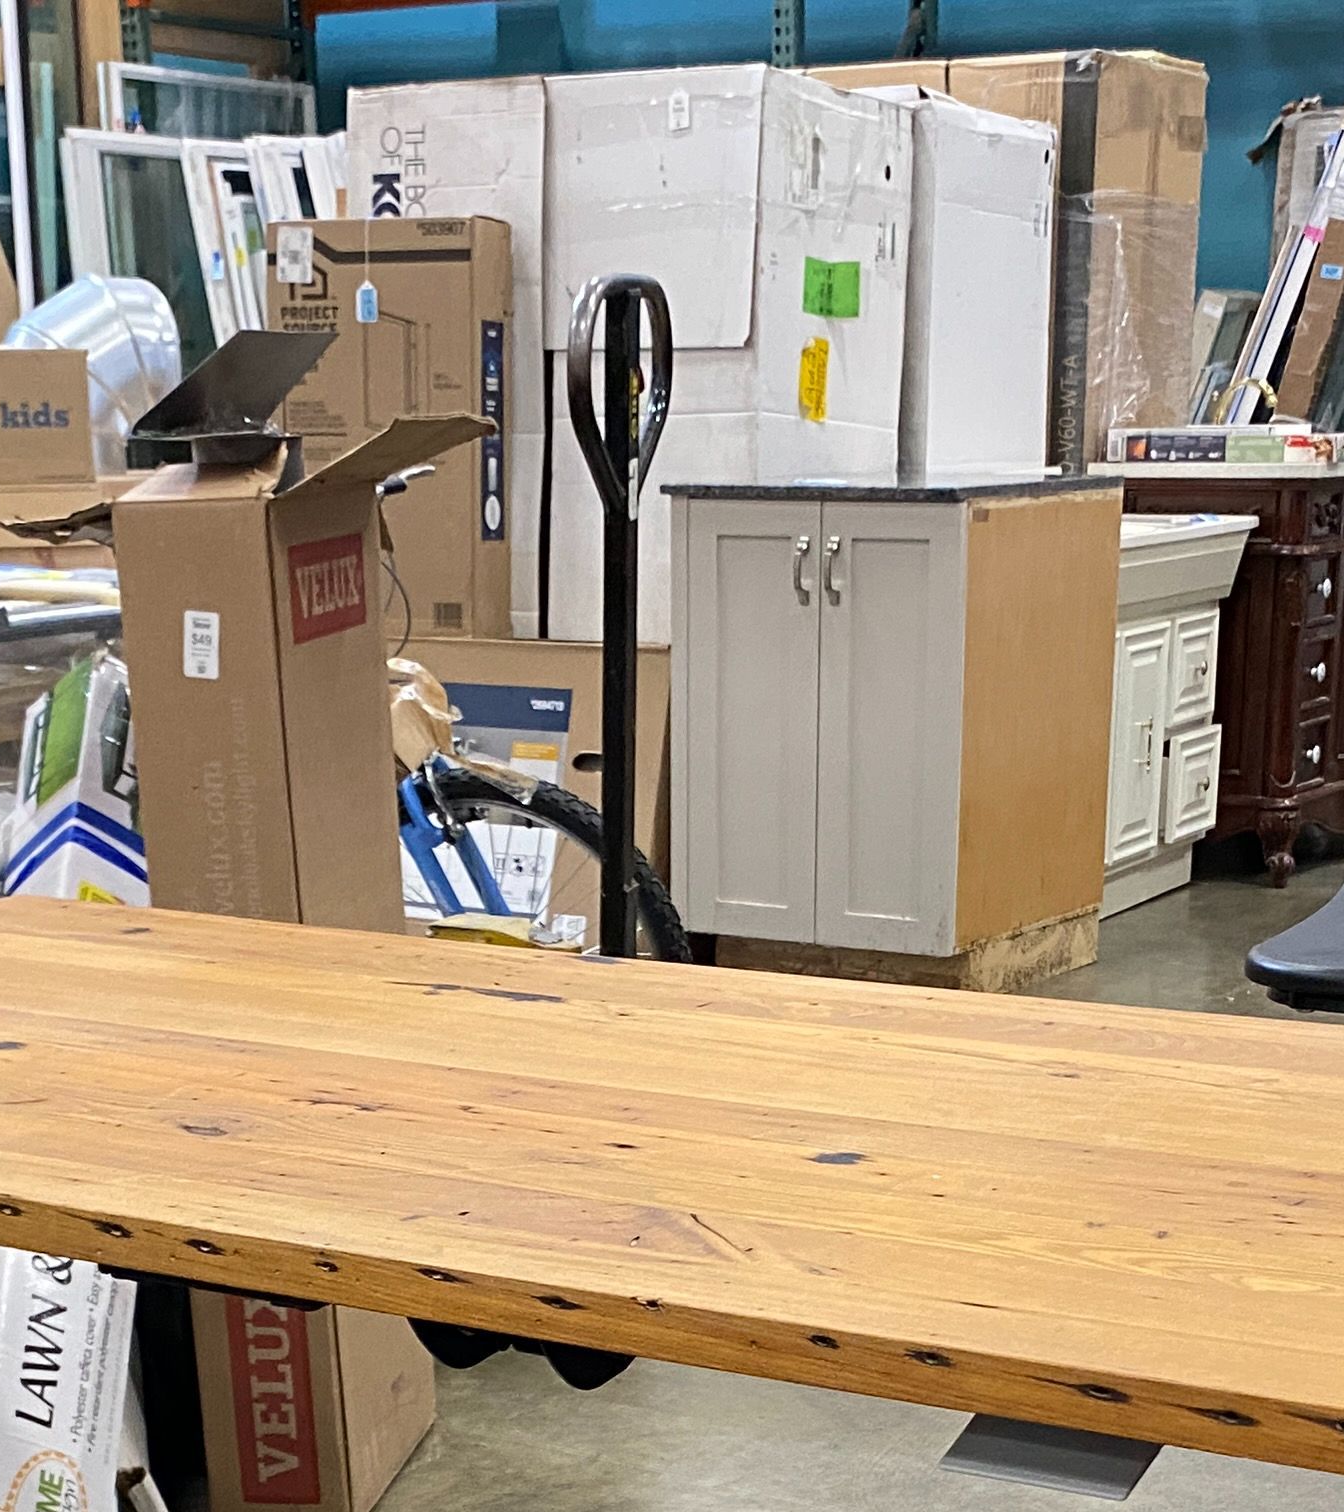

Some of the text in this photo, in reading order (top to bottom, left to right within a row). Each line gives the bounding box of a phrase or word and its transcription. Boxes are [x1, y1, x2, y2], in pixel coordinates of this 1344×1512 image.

[379, 126, 403, 166] OF
[405, 124, 426, 176] THE
[280, 305, 339, 321] PROJECT
[296, 555, 361, 620] VELUX
[191, 632, 213, 647] $49
[15, 1254, 74, 1429] LAWN &
[243, 1299, 300, 1484] VELUX
